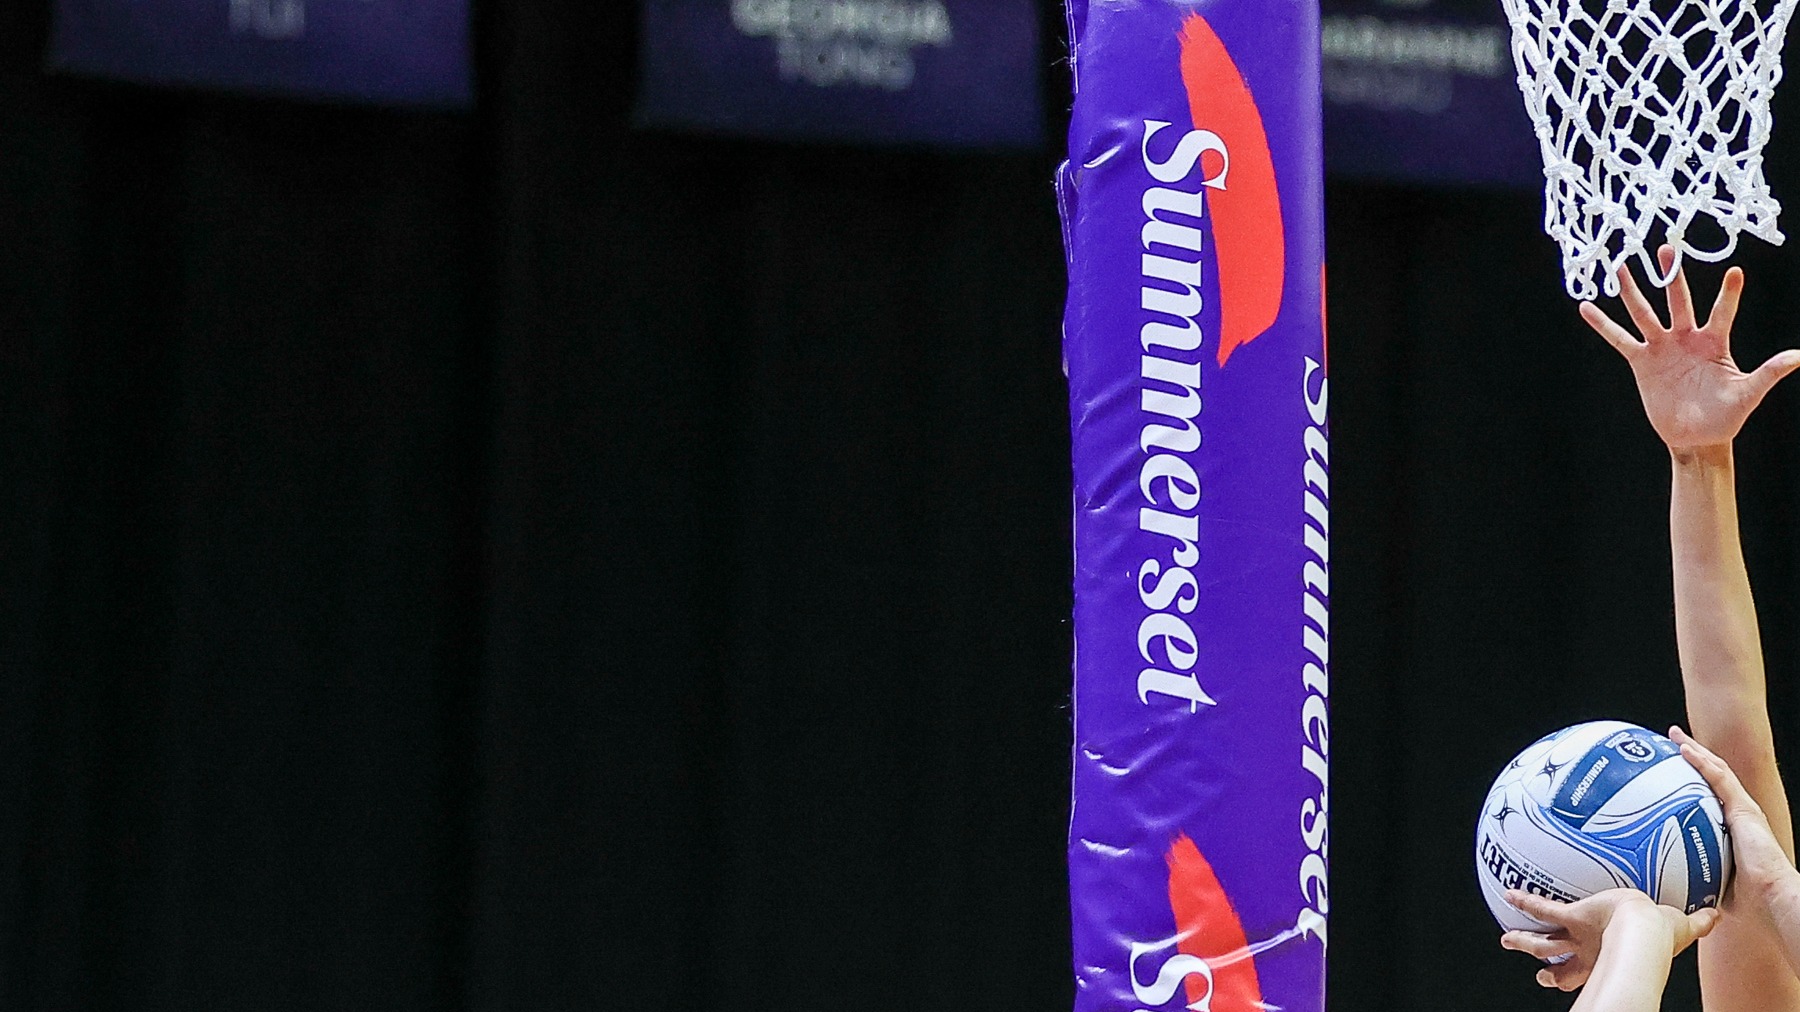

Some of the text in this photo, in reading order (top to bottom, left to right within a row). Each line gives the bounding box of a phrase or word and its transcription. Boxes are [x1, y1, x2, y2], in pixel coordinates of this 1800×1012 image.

[1136, 119, 1229, 713] Summerset
[1570, 755, 1610, 807] PREMIERSHIP
[1688, 825, 1712, 884] PREMIERSHIP
